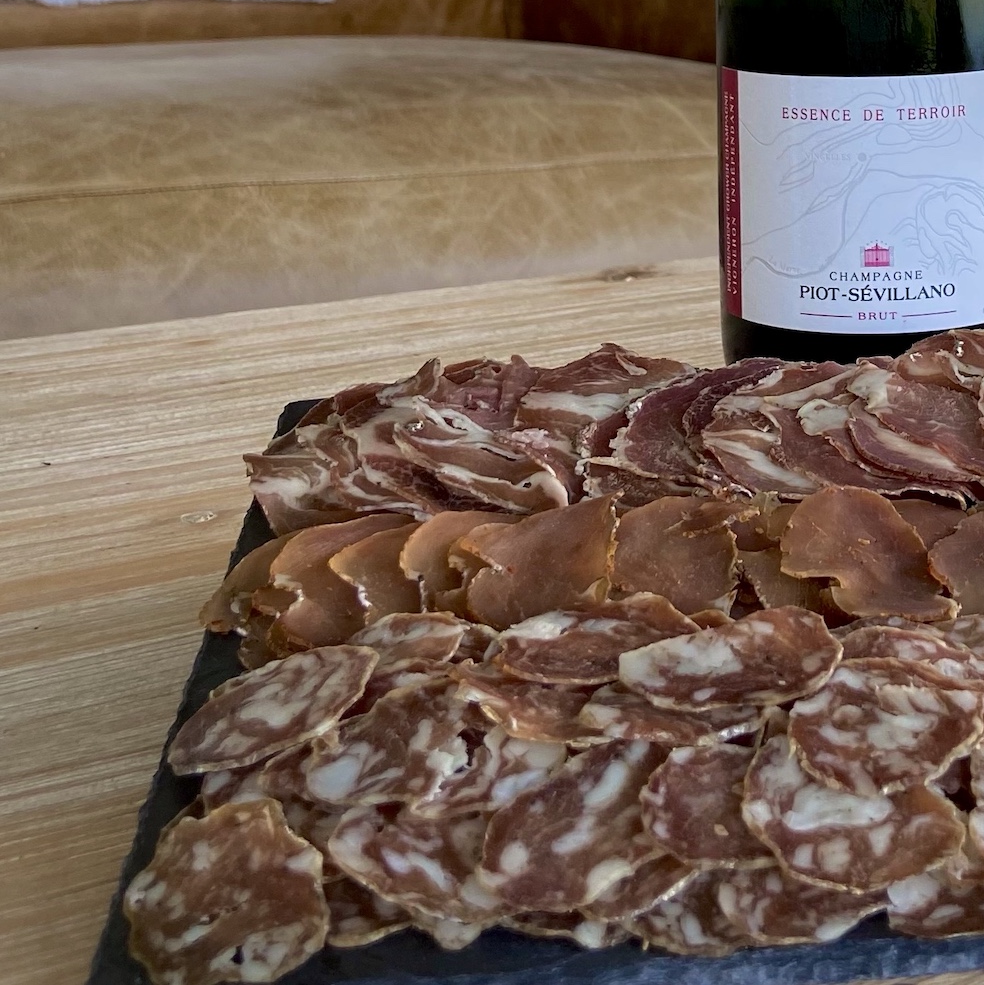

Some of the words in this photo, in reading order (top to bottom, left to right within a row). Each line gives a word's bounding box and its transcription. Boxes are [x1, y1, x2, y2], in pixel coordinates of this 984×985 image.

[782, 107, 851, 122] ESSENCE
[863, 109, 885, 122] DE
[896, 105, 967, 121] TERROIR
[829, 270, 923, 282] CHAMPAGNE
[799, 283, 956, 302] PIOT-SÉVILLANO
[858, 311, 898, 321] BRUT
